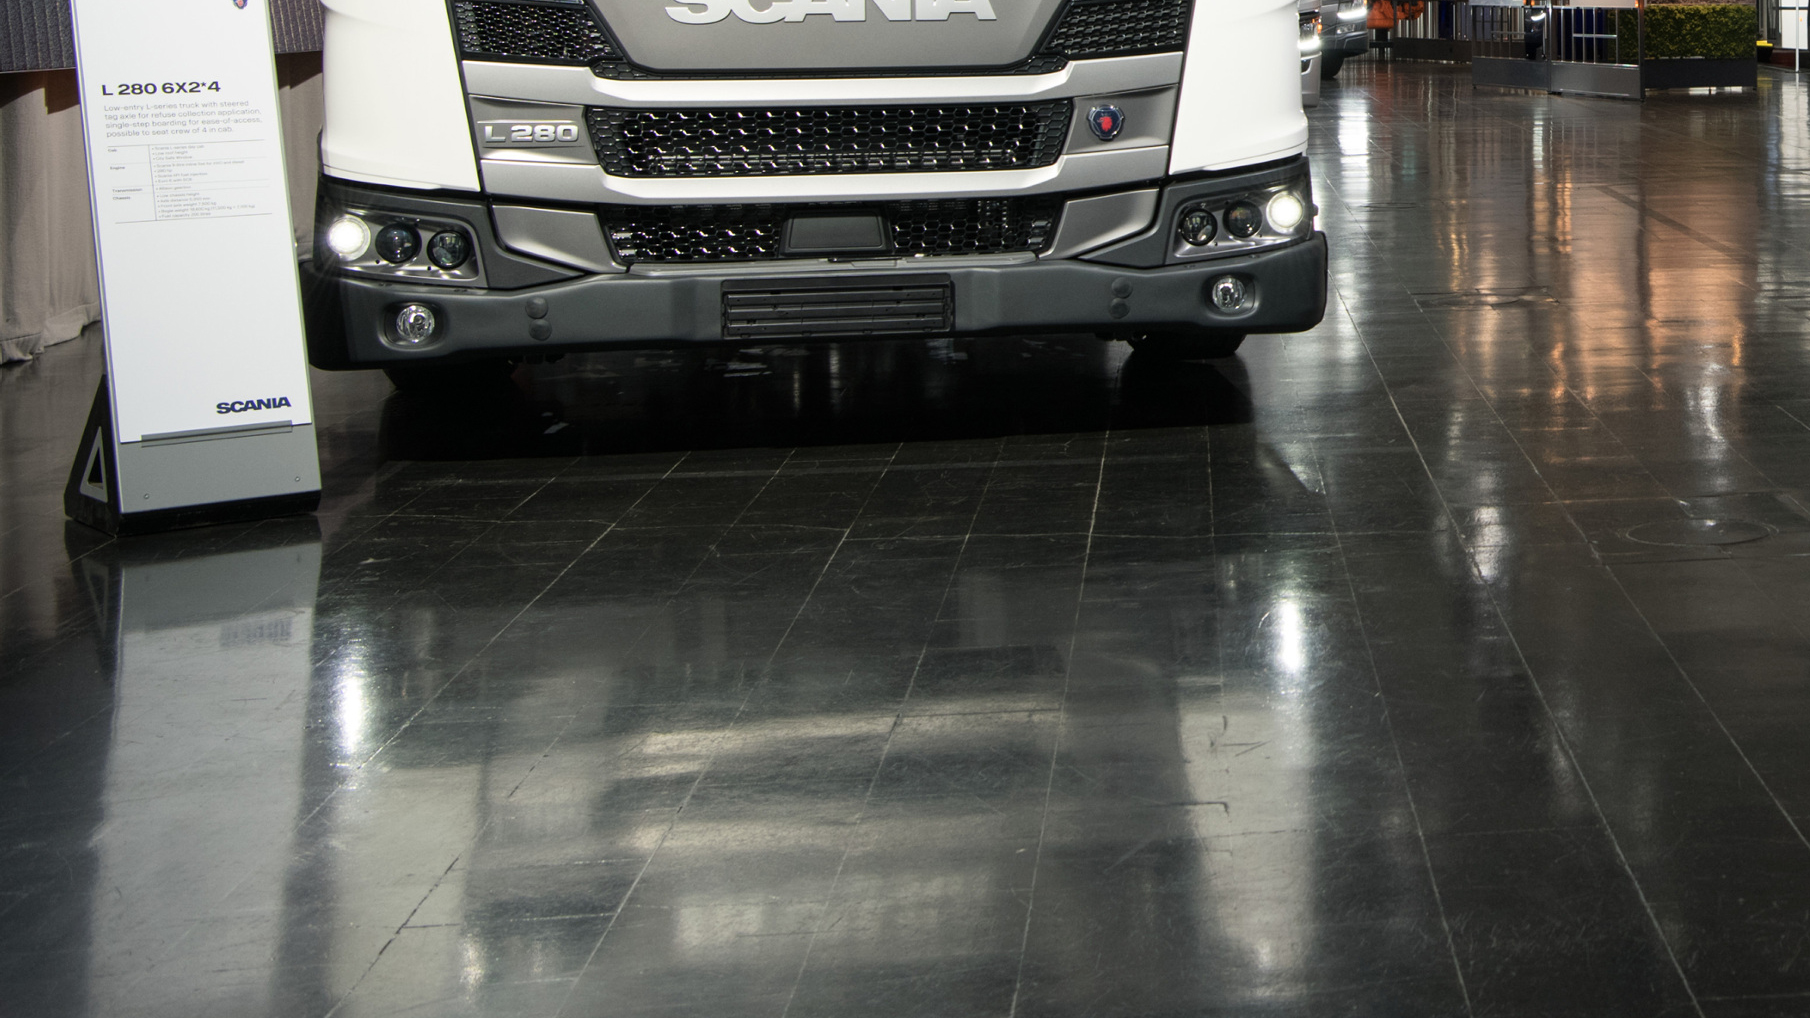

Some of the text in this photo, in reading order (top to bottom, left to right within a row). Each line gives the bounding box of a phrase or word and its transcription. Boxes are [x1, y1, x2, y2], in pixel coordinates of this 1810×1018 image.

[102, 85, 113, 95] L
[118, 83, 157, 95] 280
[104, 104, 144, 112] Low-entry
[106, 130, 139, 138] possible
[485, 124, 578, 143] L 280
[216, 396, 292, 414] SCANIA
